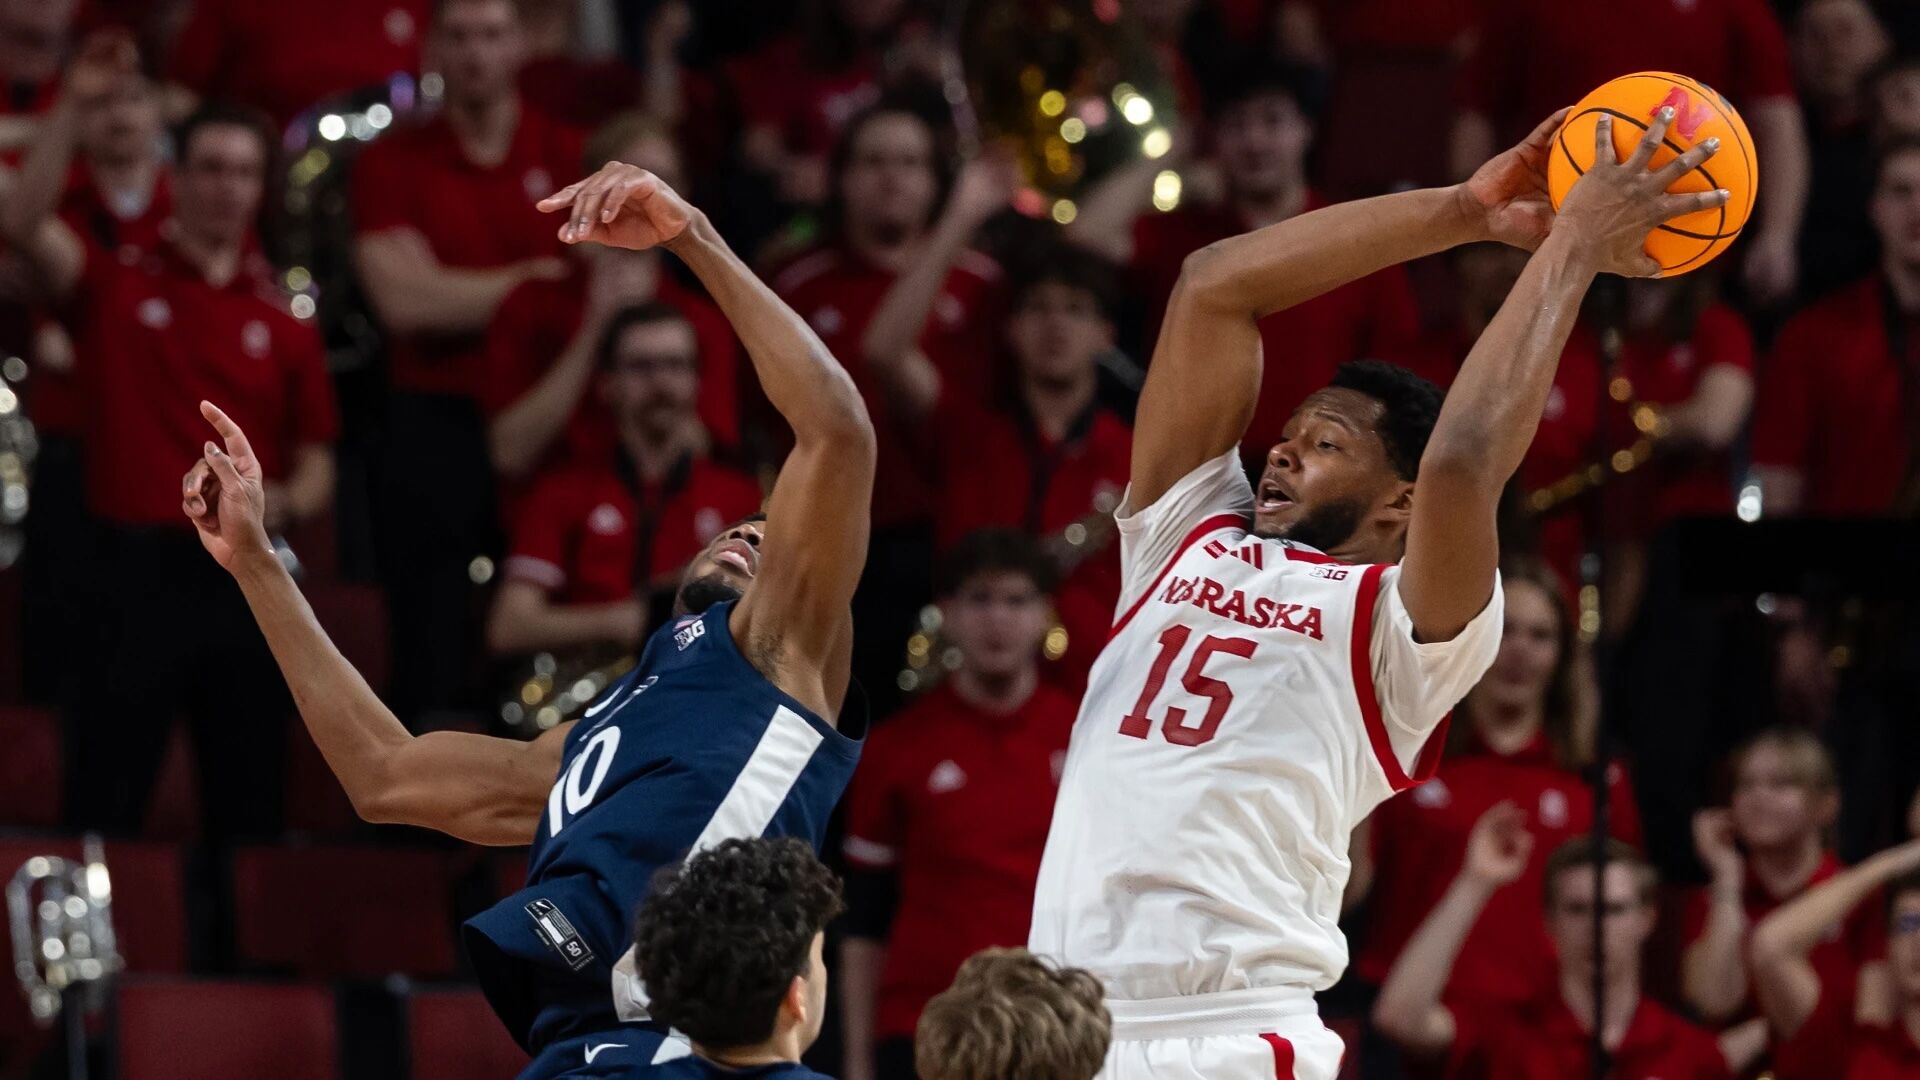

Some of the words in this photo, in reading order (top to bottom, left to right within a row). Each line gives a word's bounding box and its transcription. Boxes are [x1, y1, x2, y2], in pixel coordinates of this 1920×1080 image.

[1118, 624, 1259, 747] 15
[548, 725, 621, 838] 10
[566, 941, 582, 957] 50
